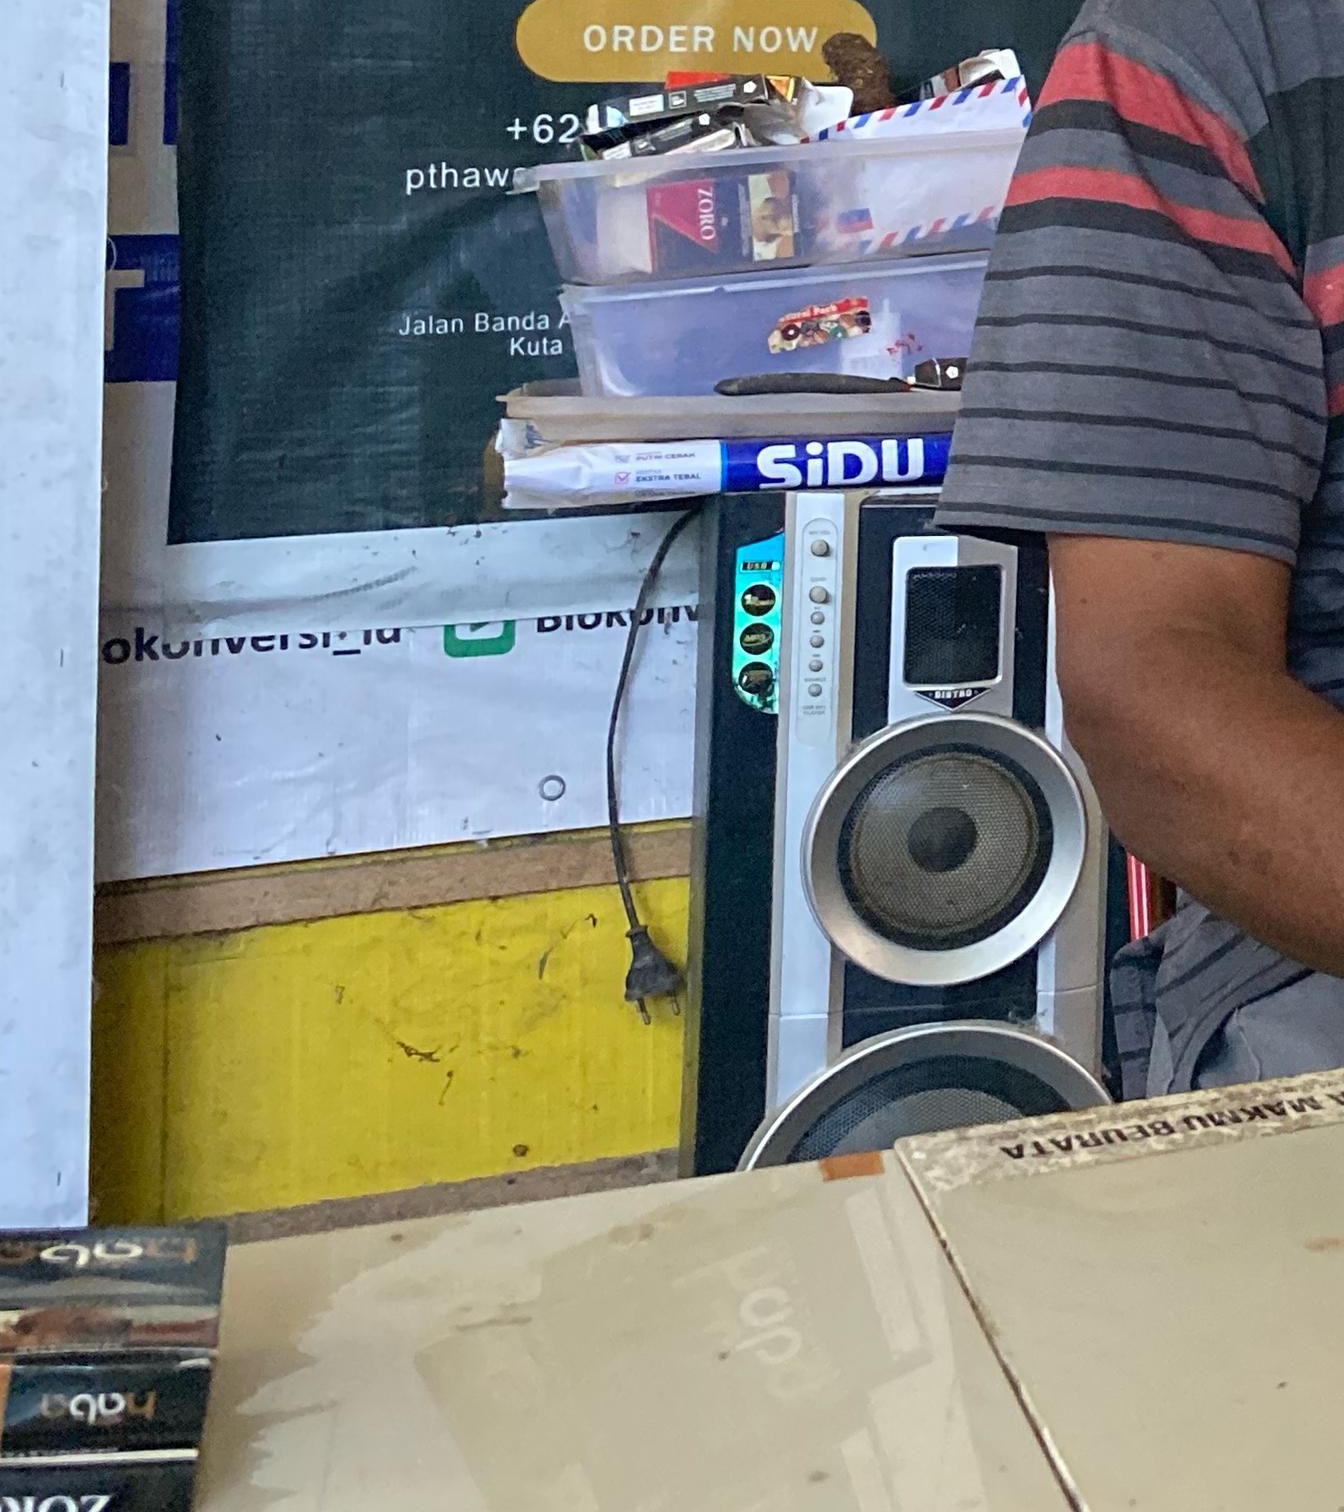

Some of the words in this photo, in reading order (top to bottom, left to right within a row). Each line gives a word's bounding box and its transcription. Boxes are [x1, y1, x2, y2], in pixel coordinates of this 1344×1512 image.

[582, 24, 715, 54] ORDER
[733, 25, 819, 54] NOW
[506, 113, 580, 144] +62
[405, 161, 530, 196] pthaw
[697, 187, 717, 241] ZORO
[399, 315, 464, 336] Jalan
[474, 311, 550, 332] Banda
[509, 336, 563, 356] Kuta
[757, 437, 925, 491] SiDU
[1182, 1093, 1321, 1132] MAKMU
[1000, 1119, 1175, 1161] BEURATA
